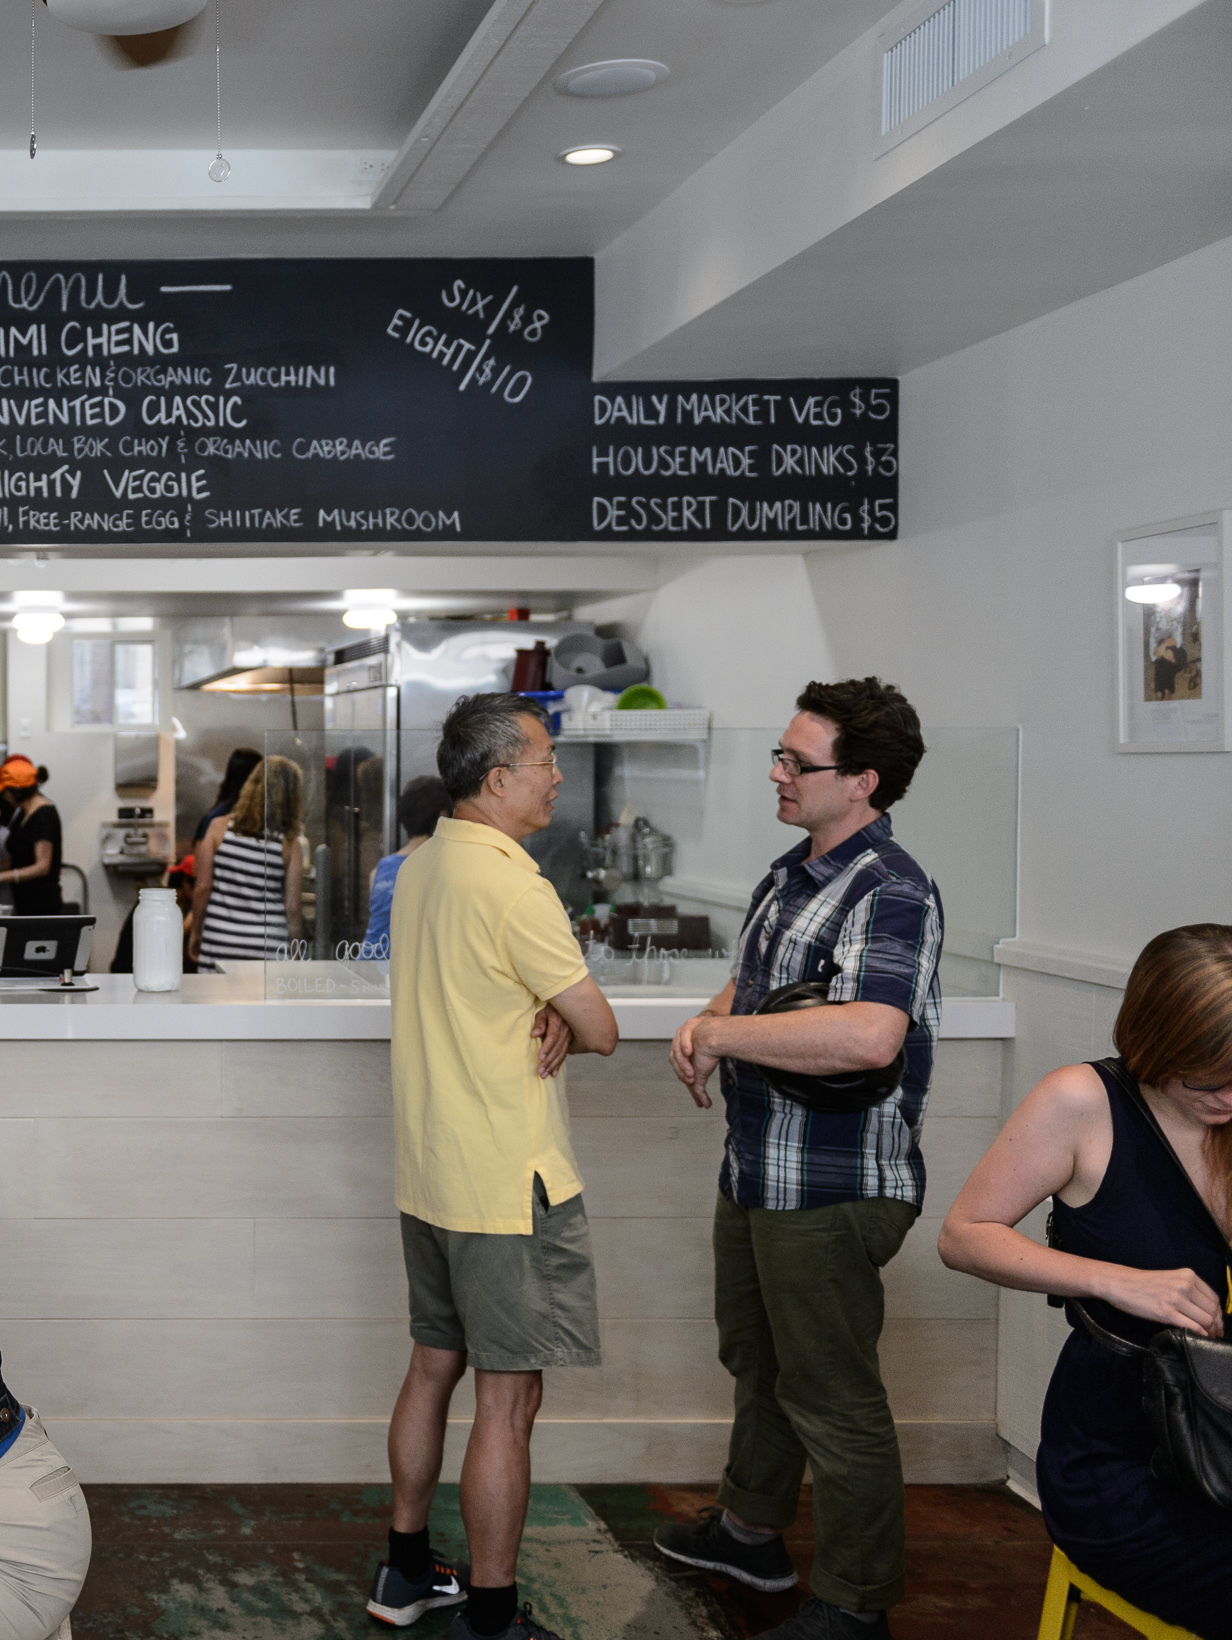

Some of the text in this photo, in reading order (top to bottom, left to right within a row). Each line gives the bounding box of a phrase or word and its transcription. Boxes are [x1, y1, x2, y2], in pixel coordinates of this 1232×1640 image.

[61, 321, 179, 357] CHENG
[118, 366, 212, 388] ORGANIC
[224, 363, 335, 389] ZUCCHINI
[141, 394, 247, 429] CLASSIC
[594, 387, 890, 427] DAILY MARKET VEG $5
[16, 435, 68, 457] LOCAL
[72, 436, 112, 459] BOK
[118, 436, 169, 457] CHOY
[195, 437, 282, 459] ORGANIC
[292, 437, 396, 461] CABBAGE
[592, 442, 898, 477] HOUSEMADE DRINKS $3
[103, 469, 211, 500] VEGGIE
[19, 506, 134, 531] FREE-RANGE
[141, 509, 179, 530] EGG
[205, 508, 303, 528] SHIITAKE
[318, 508, 461, 532] MUSHROOM
[592, 495, 896, 536] DESSERT DUMPLING $5
[275, 938, 312, 961] all
[335, 933, 390, 967] good
[276, 977, 337, 994] BOILED
